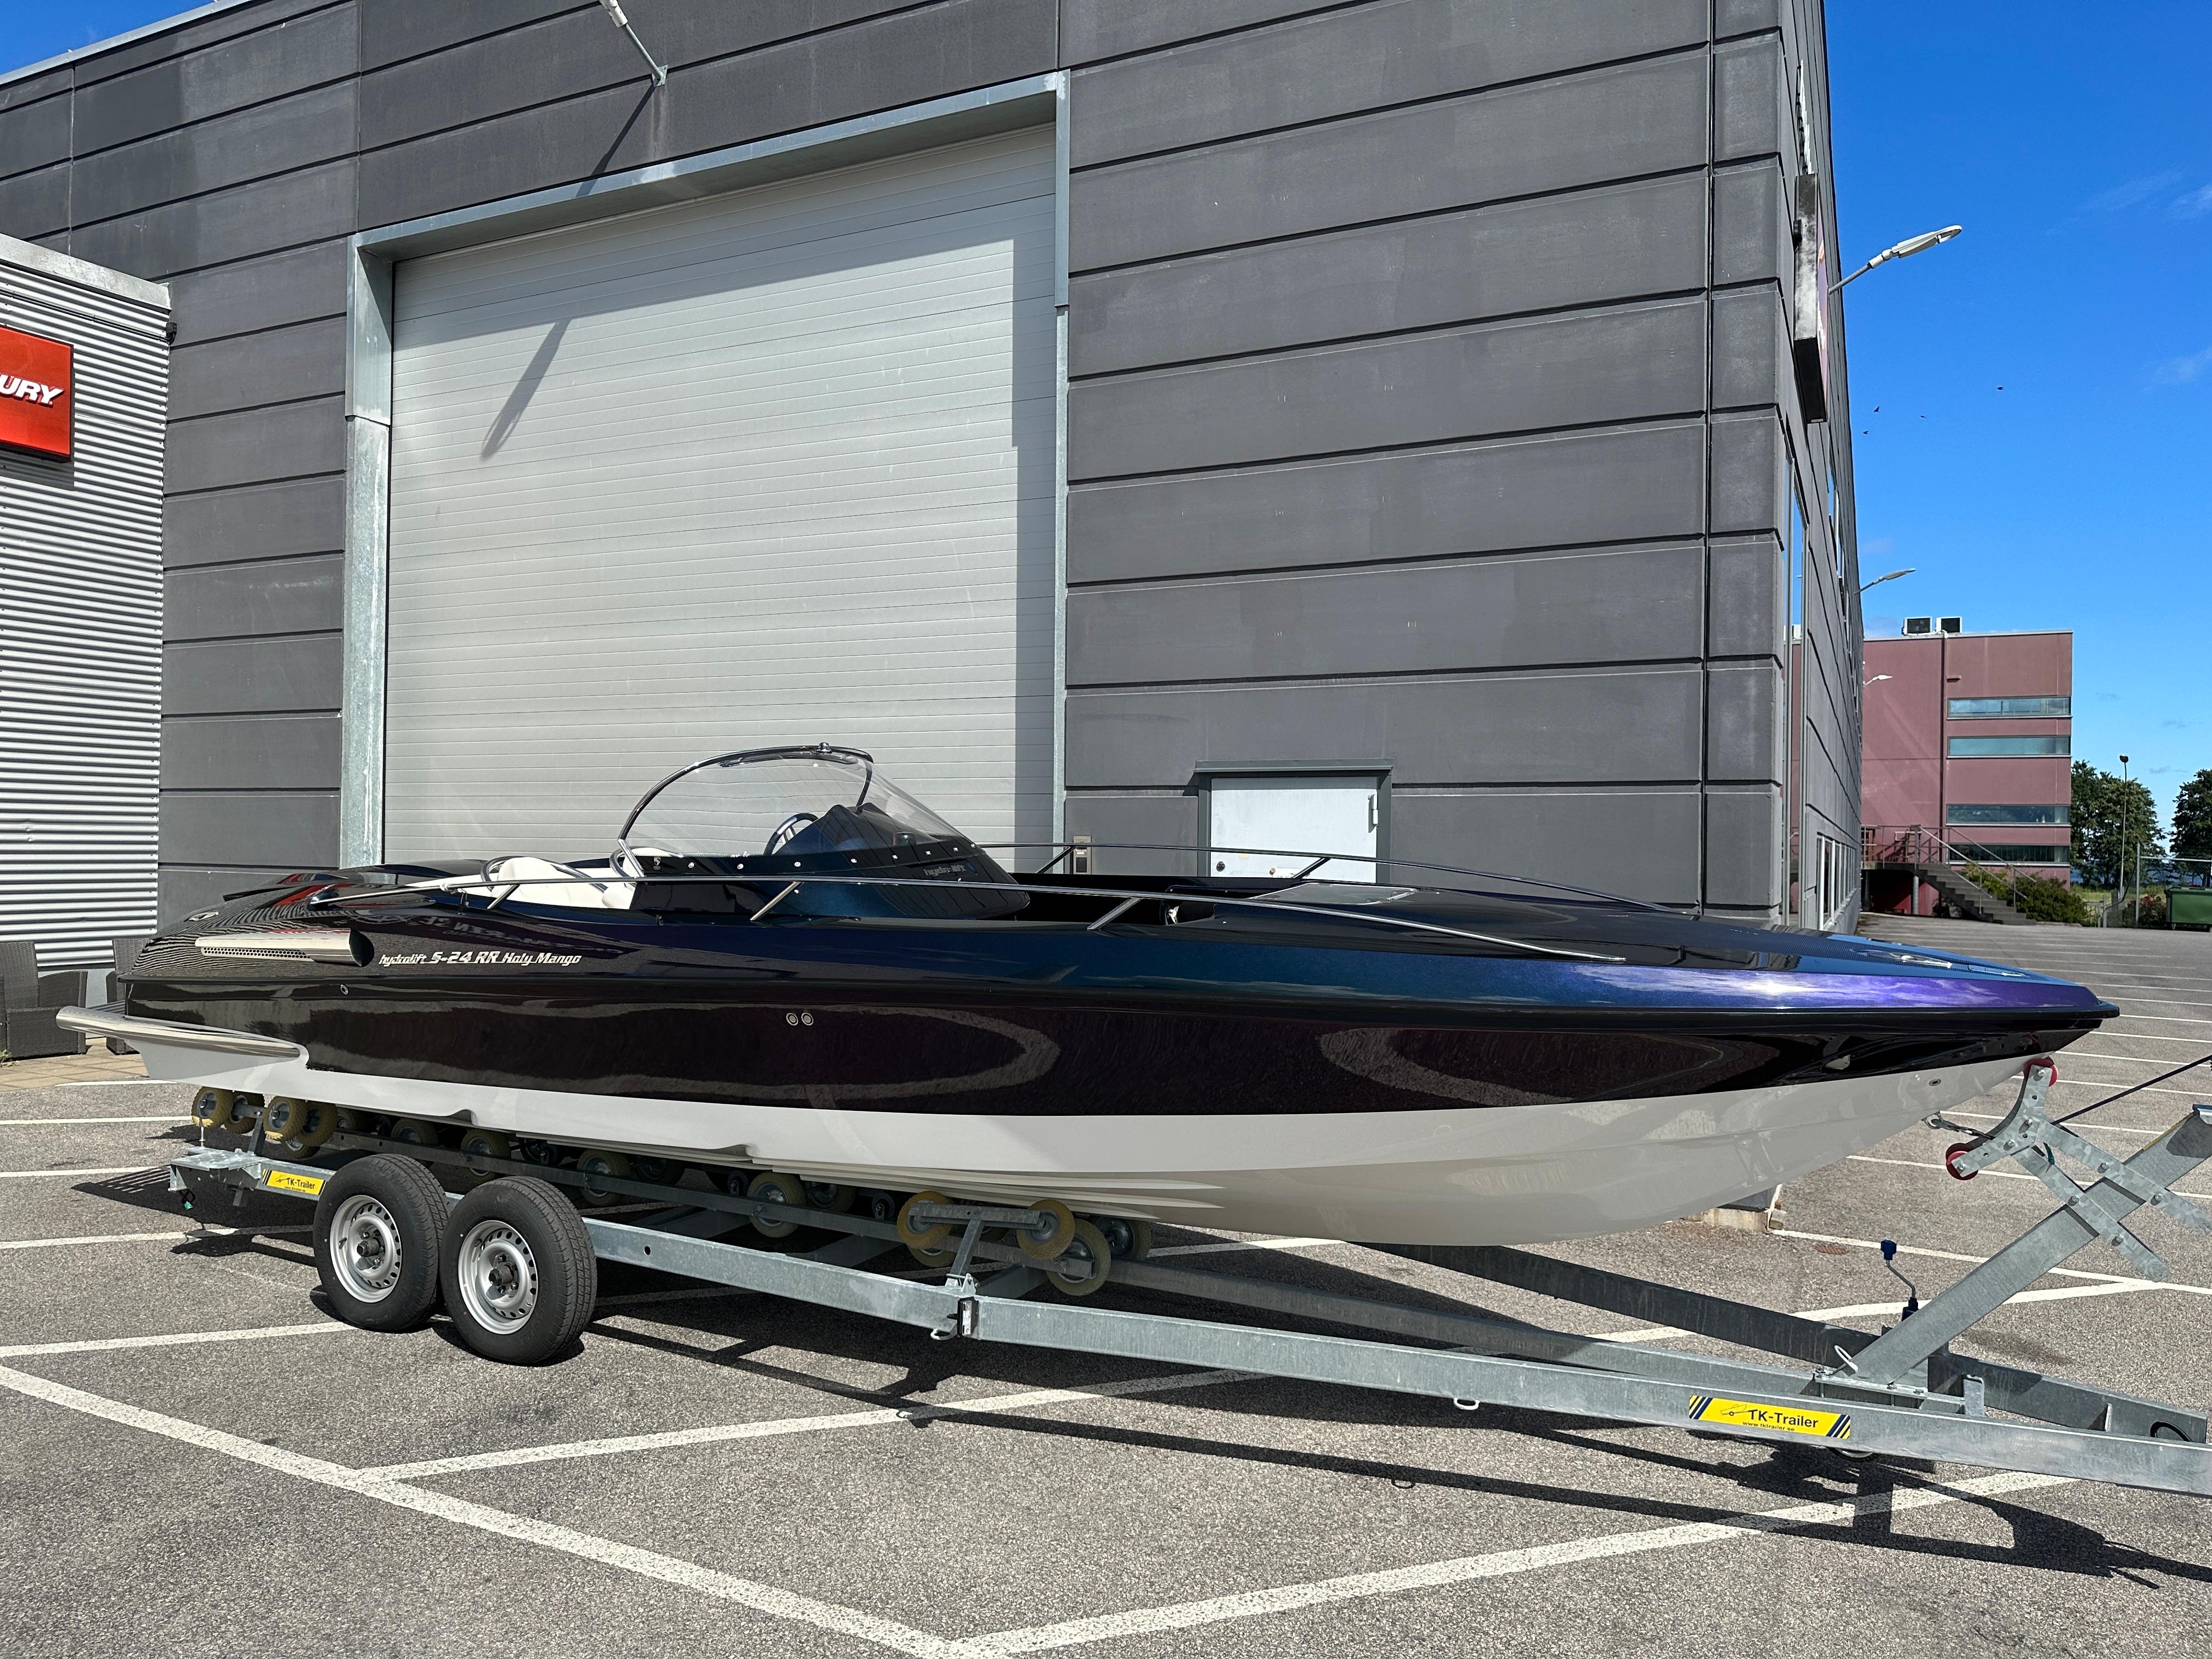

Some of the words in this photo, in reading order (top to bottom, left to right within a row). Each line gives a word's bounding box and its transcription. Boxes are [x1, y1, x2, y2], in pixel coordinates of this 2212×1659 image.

[379, 954, 427, 967] hydrolift
[475, 951, 501, 963] RR
[503, 952, 534, 966] Holy
[536, 953, 582, 966] Mango
[286, 1178, 315, 1189] TK-Trailer
[1748, 1409, 1819, 1427] TK-Trailer
